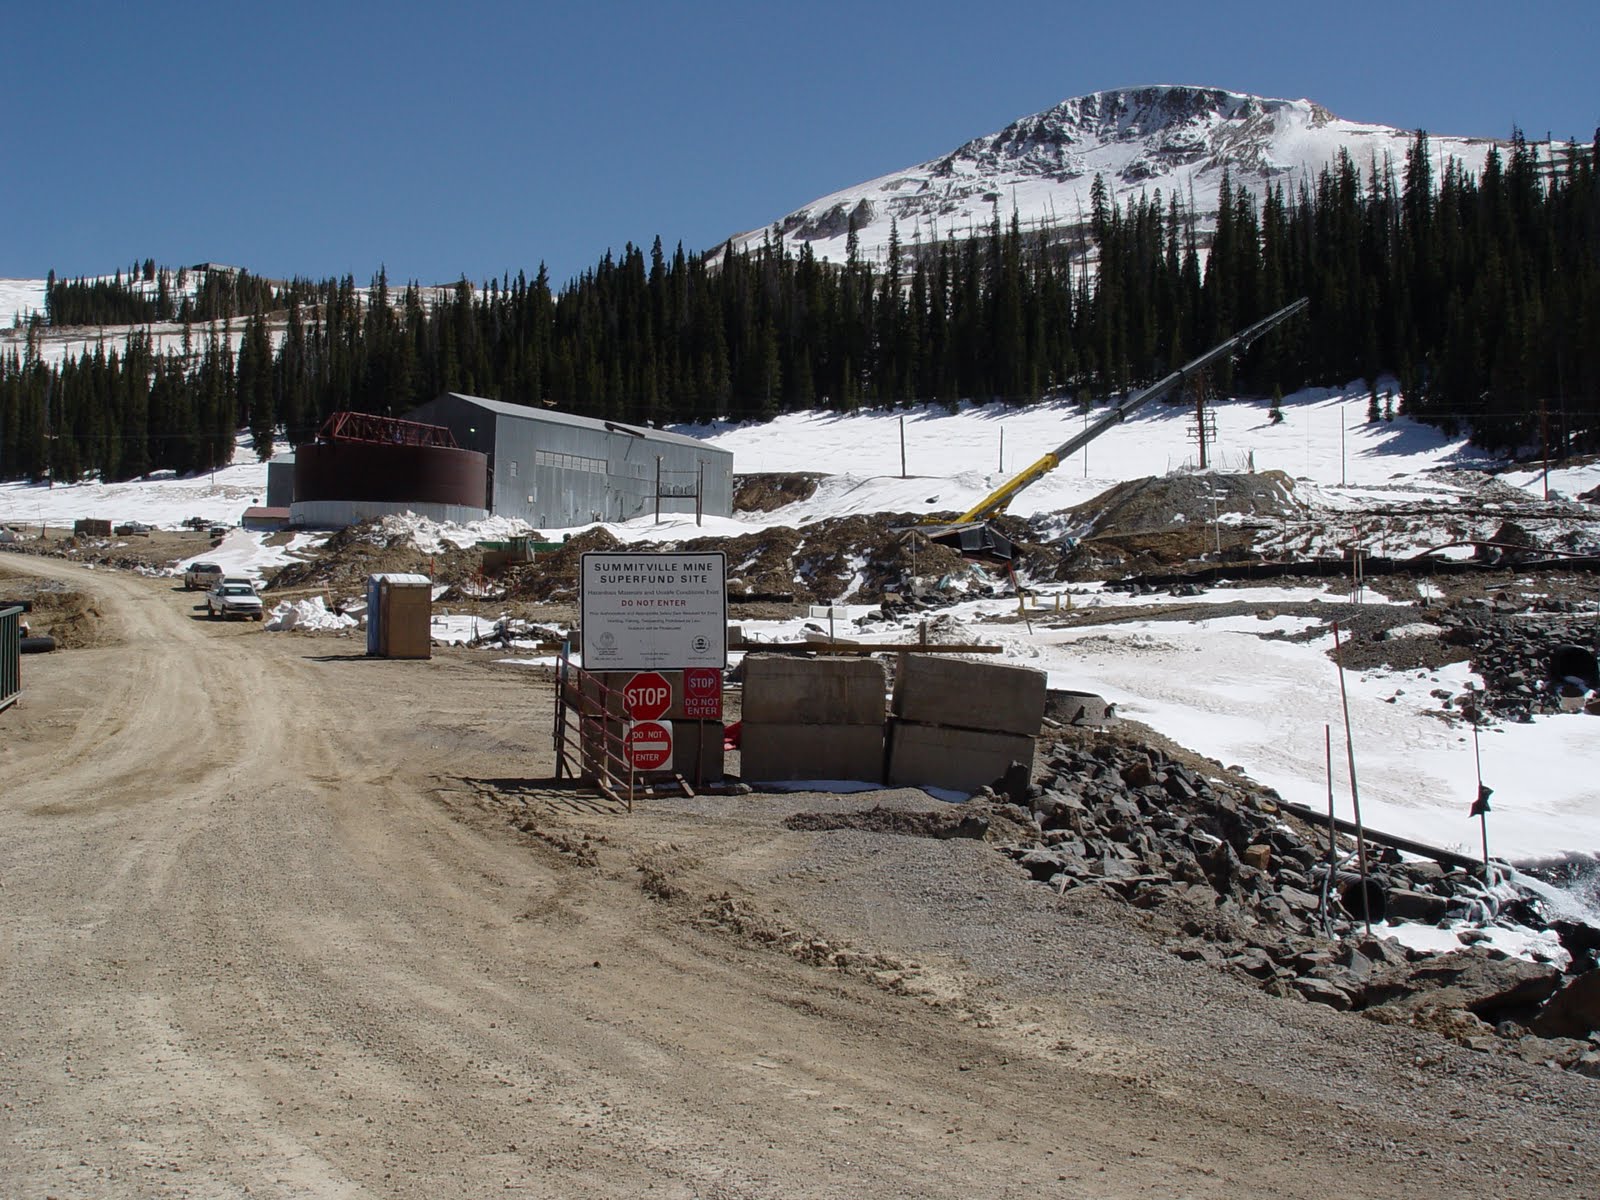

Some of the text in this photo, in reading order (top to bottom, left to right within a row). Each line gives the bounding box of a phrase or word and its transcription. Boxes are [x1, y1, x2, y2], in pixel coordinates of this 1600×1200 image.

[594, 562, 713, 572] SUMMITVILLE MINE
[600, 574, 708, 584] SUPERFUND SITE
[621, 599, 687, 607] DO NOT ENTER
[690, 677, 714, 688] STOP
[628, 687, 667, 707] STOP
[685, 698, 720, 707] DO NOT
[687, 707, 717, 715] ENTER
[632, 731, 663, 739] DO NOT
[635, 753, 660, 762] ENTER
